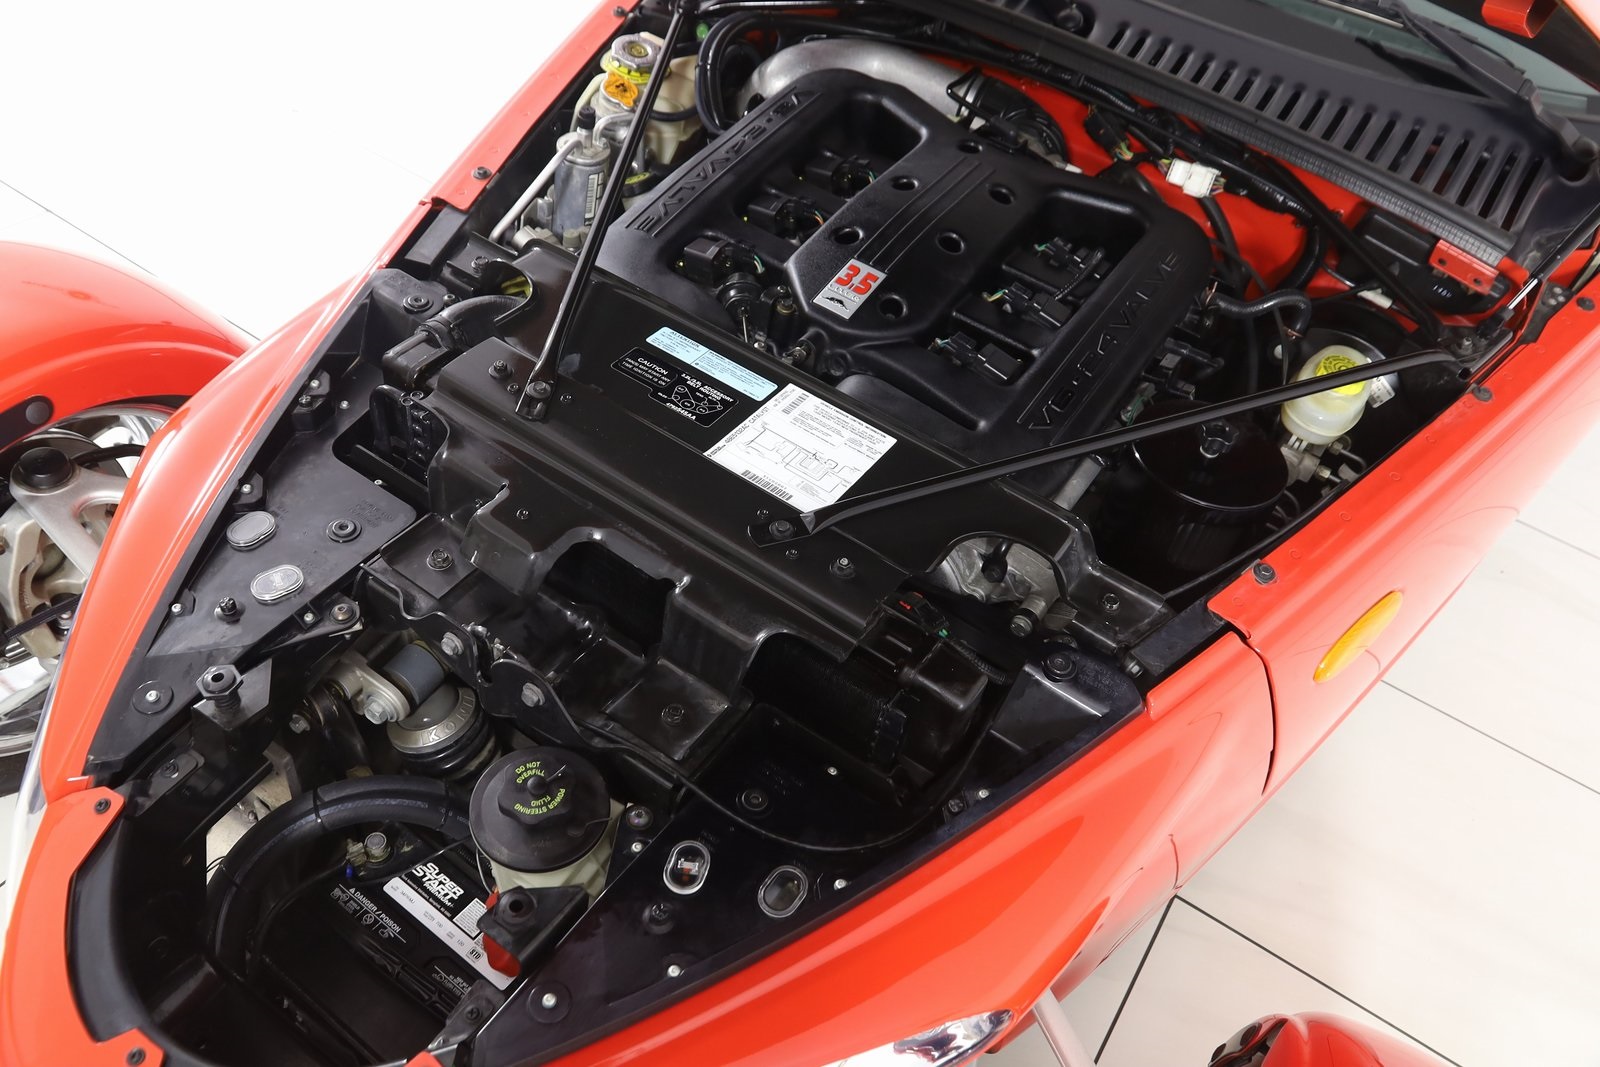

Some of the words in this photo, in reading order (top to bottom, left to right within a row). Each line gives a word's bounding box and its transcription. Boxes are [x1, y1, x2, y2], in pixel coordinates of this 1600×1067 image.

[835, 264, 879, 295] 3.5
[638, 357, 668, 375] CAUTION
[686, 380, 699, 390] BELT
[699, 386, 721, 400] ROUTING
[703, 385, 734, 402] ACCESSORY
[515, 765, 526, 774] DO
[526, 761, 541, 769] NOT
[516, 769, 545, 784] OVERFILL
[530, 795, 551, 807] FLUID
[547, 788, 566, 810] POWER
[514, 803, 548, 815] STEERING
[412, 865, 458, 900] START
[424, 862, 465, 898] SUPER
[354, 890, 379, 912] DANGER
[380, 912, 402, 933] POISON
